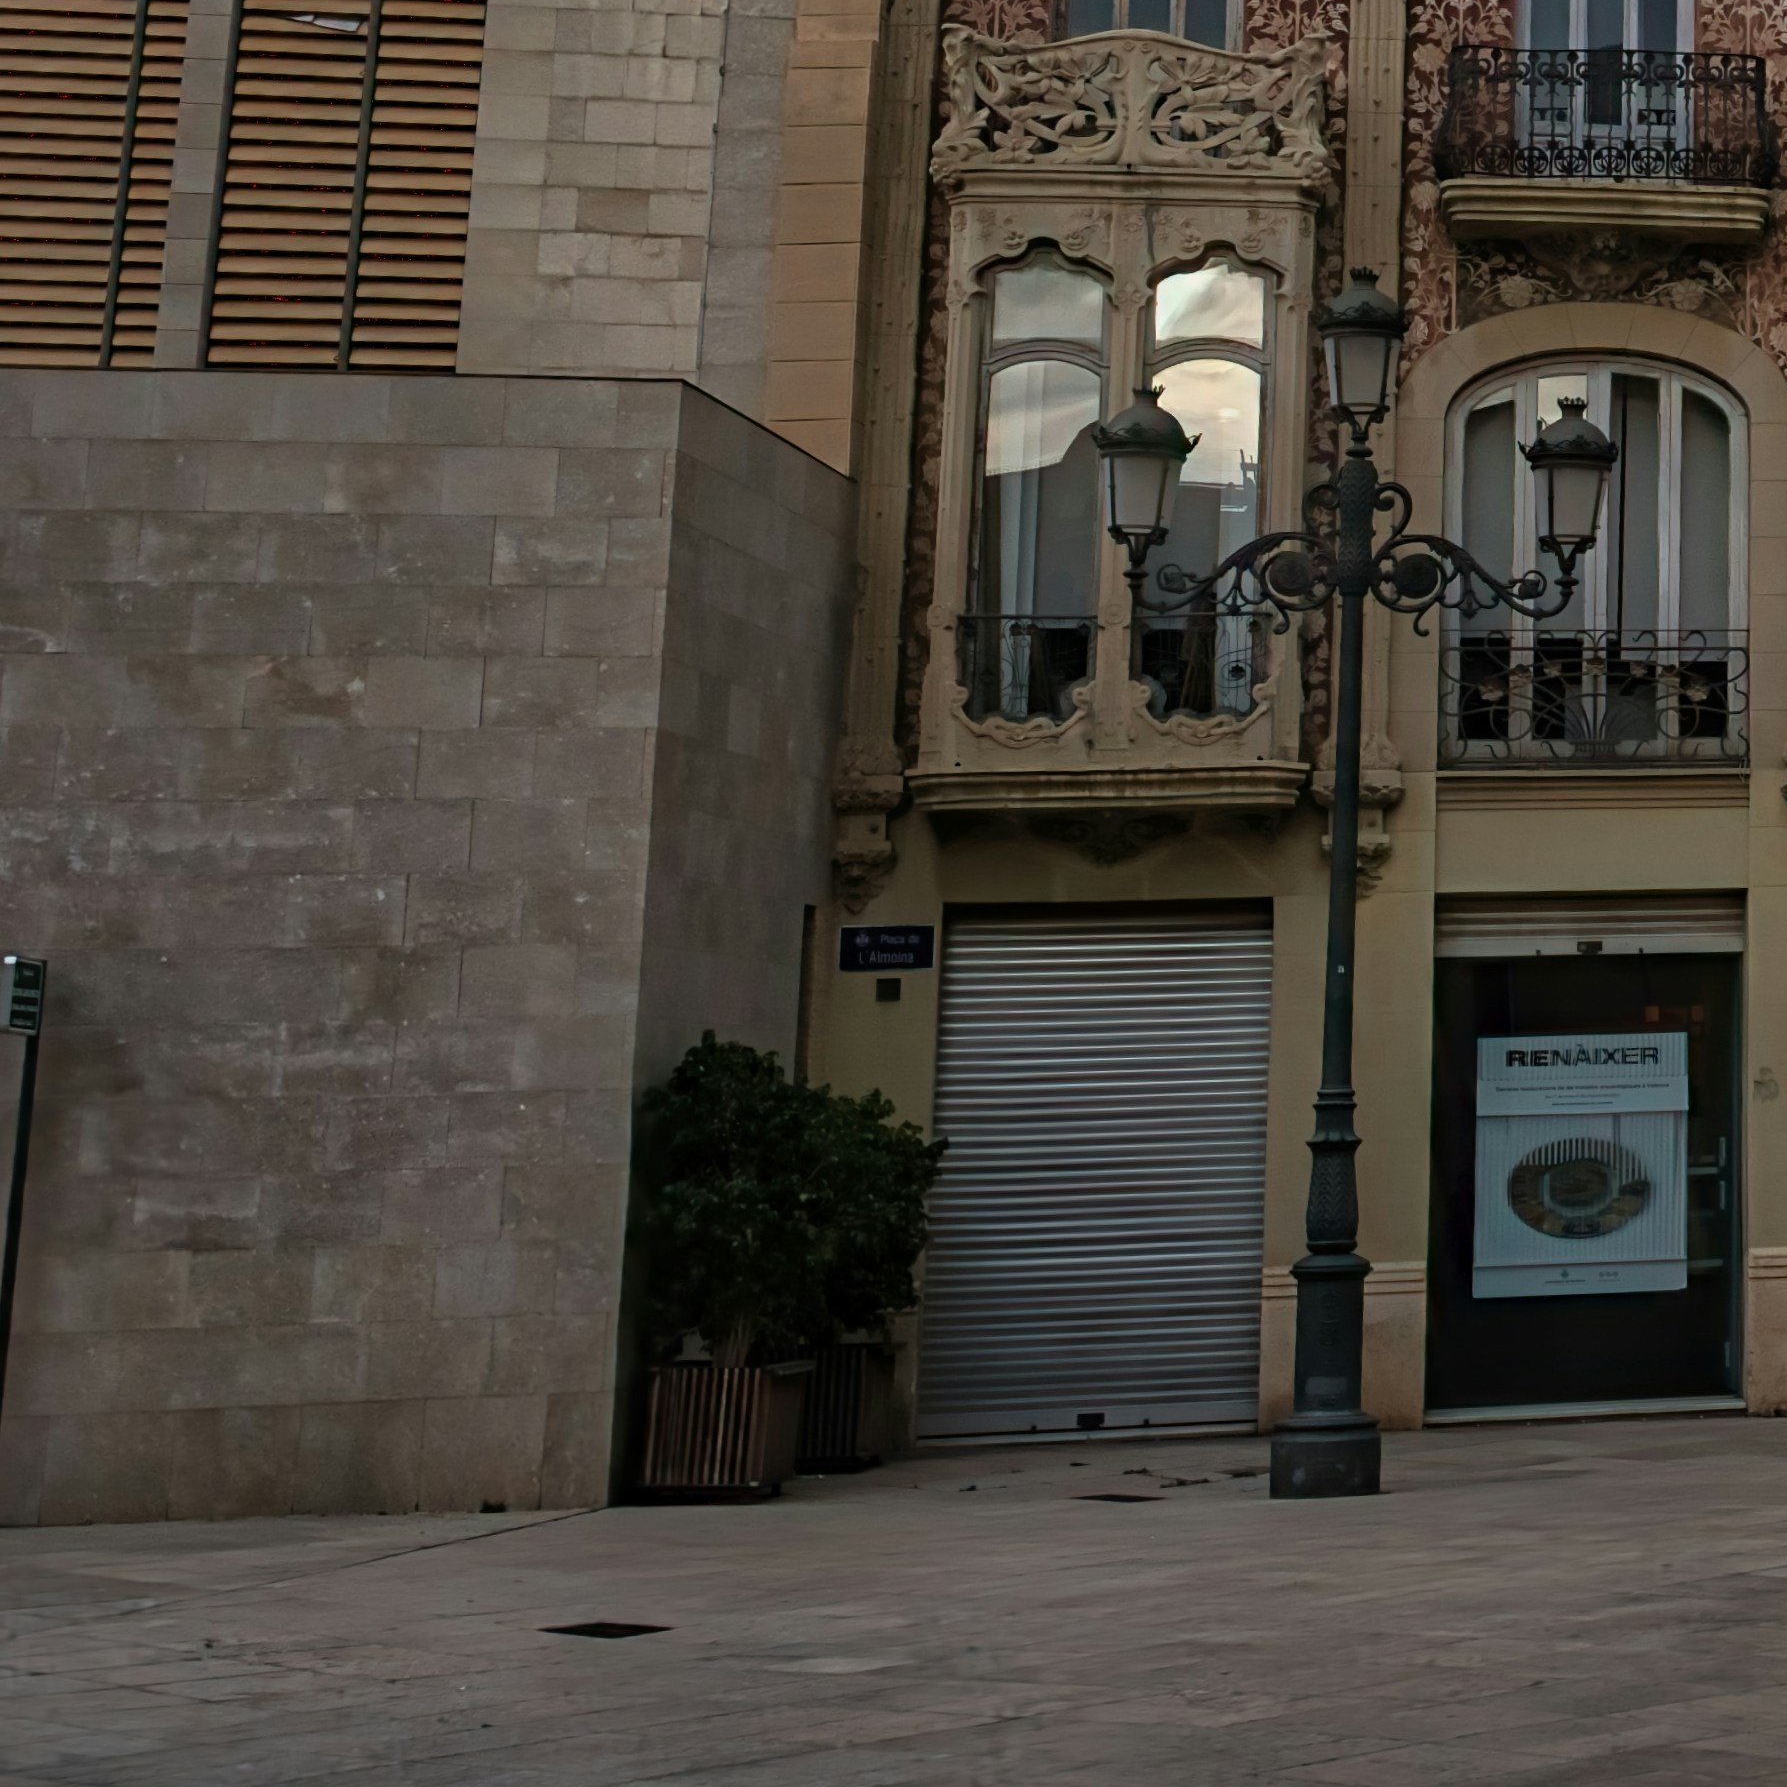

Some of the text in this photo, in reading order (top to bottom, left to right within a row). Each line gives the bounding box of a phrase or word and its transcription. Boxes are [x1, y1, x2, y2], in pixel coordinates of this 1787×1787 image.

[908, 934, 920, 944] de
[859, 950, 914, 965] L'Almoina
[1506, 1044, 1660, 1068] RENÀIXER
